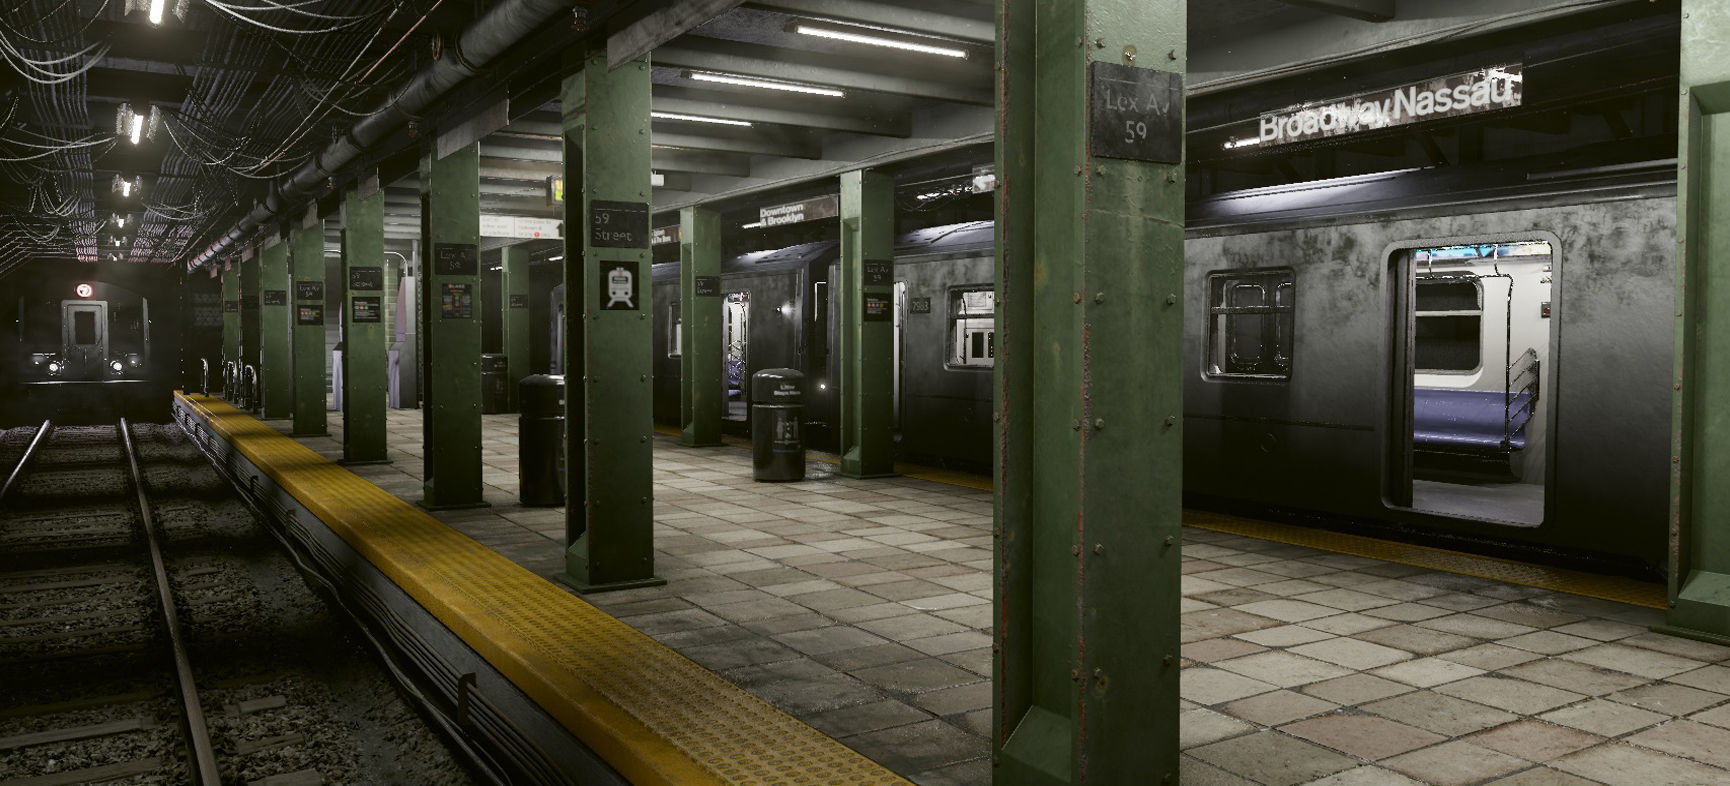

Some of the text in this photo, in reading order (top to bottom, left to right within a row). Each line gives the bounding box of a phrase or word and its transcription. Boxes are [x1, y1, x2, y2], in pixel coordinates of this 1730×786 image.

[1106, 89, 1138, 113] Lex
[1260, 78, 1512, 141] Broadway Nassau
[1125, 120, 1147, 143] 59
[595, 212, 610, 224] 59
[760, 203, 804, 218] Downtown
[767, 212, 804, 226] Brooklyn
[594, 227, 633, 242] Street
